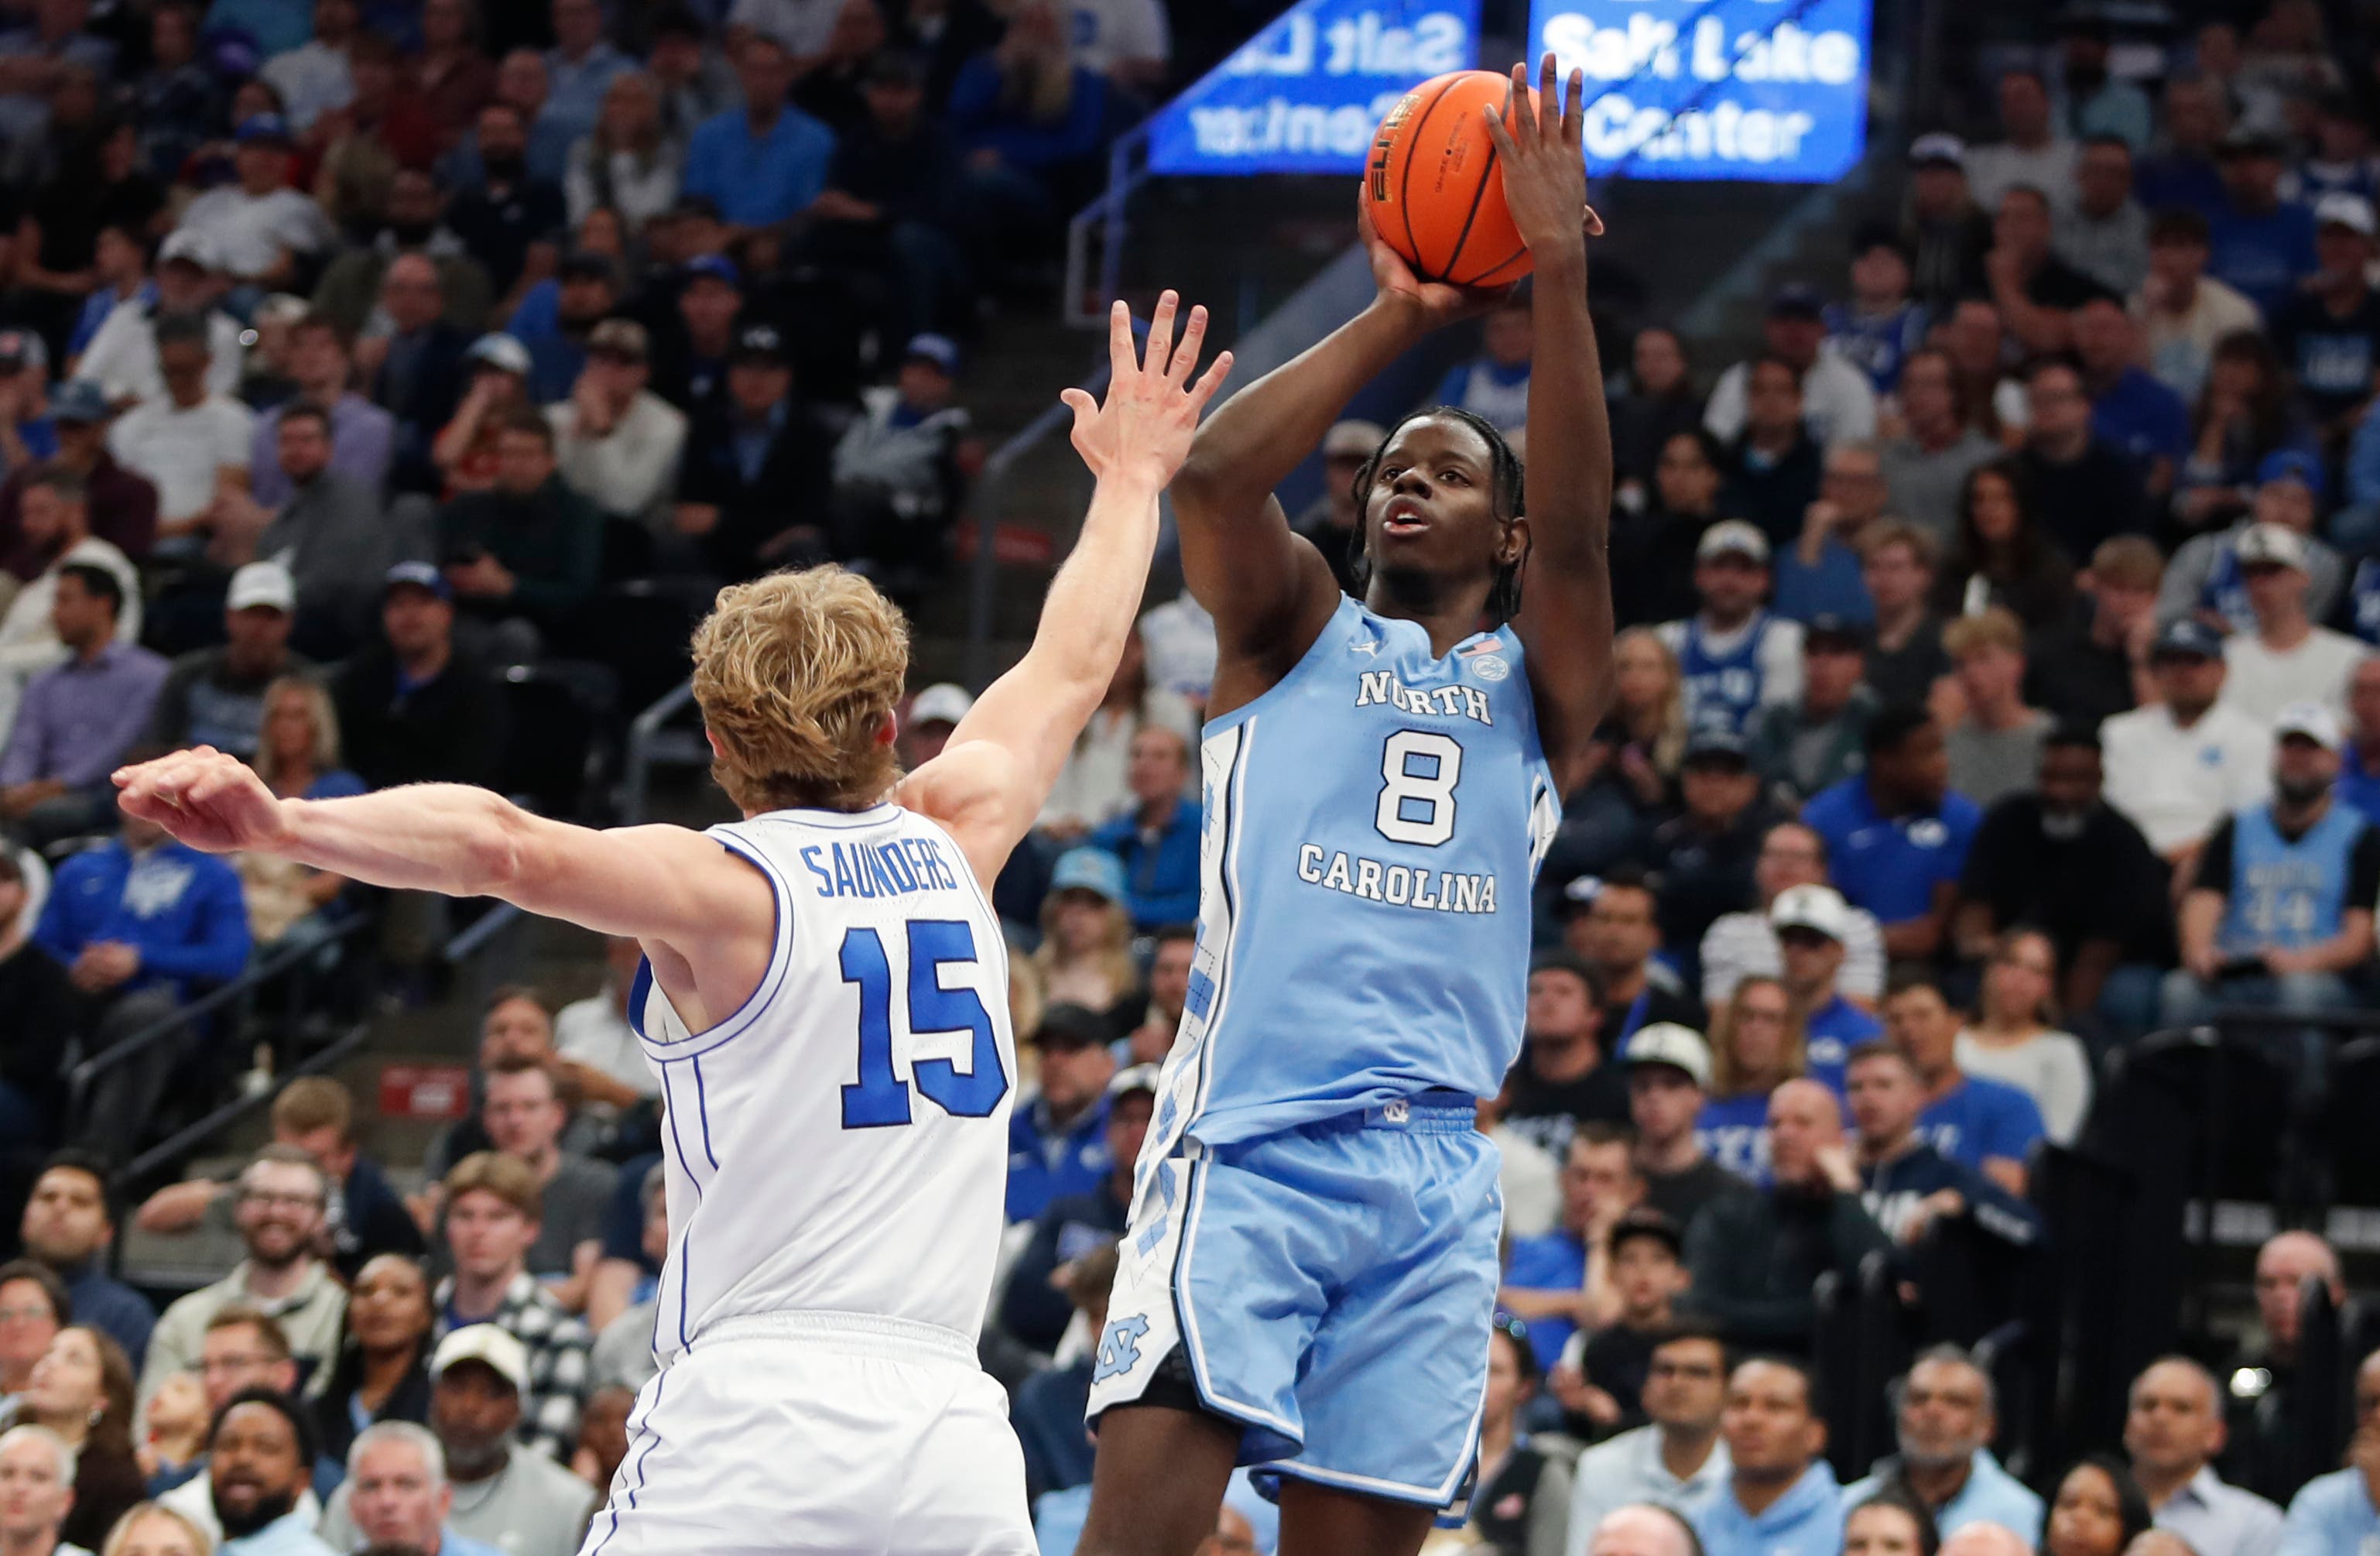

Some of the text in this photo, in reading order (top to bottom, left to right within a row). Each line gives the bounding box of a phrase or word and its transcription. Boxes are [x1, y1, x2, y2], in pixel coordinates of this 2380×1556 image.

[1355, 670, 1492, 726] NORTH
[1375, 729, 1463, 847] 8
[800, 838, 957, 899] SAUNDERS
[1298, 843, 1495, 913] CAROLINA
[838, 919, 1009, 1129] 15
